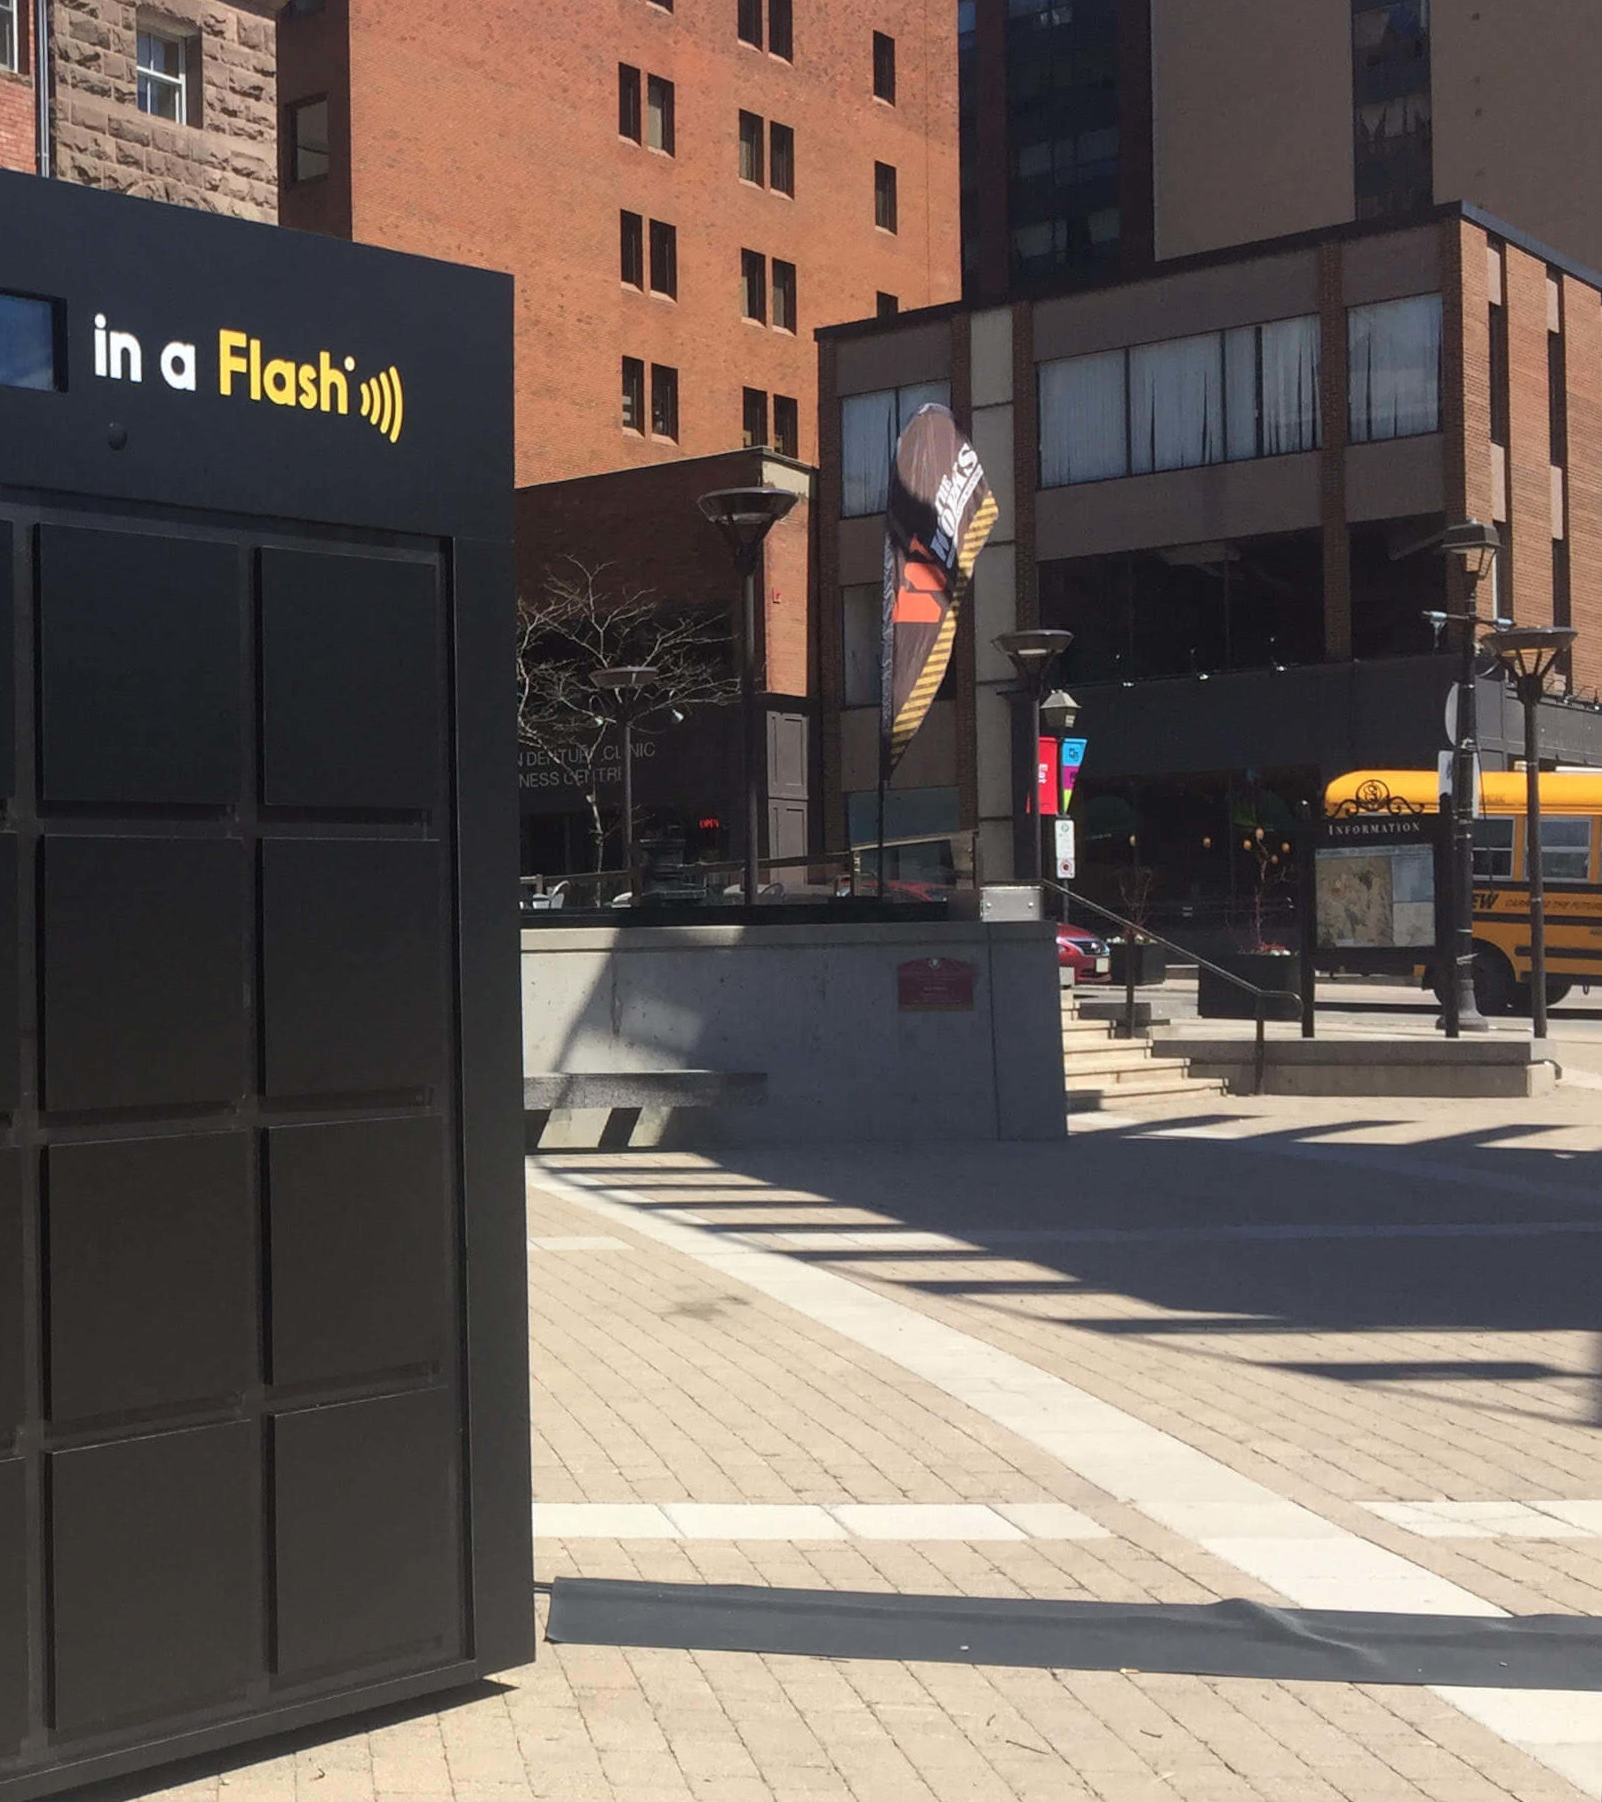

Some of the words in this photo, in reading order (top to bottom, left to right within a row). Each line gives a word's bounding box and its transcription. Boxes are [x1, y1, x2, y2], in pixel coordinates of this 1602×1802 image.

[94, 313, 142, 382] in
[160, 341, 196, 391] a
[219, 328, 348, 415] Flash
[602, 741, 656, 761] CLNIC
[1328, 822, 1420, 836] INFORMATION
